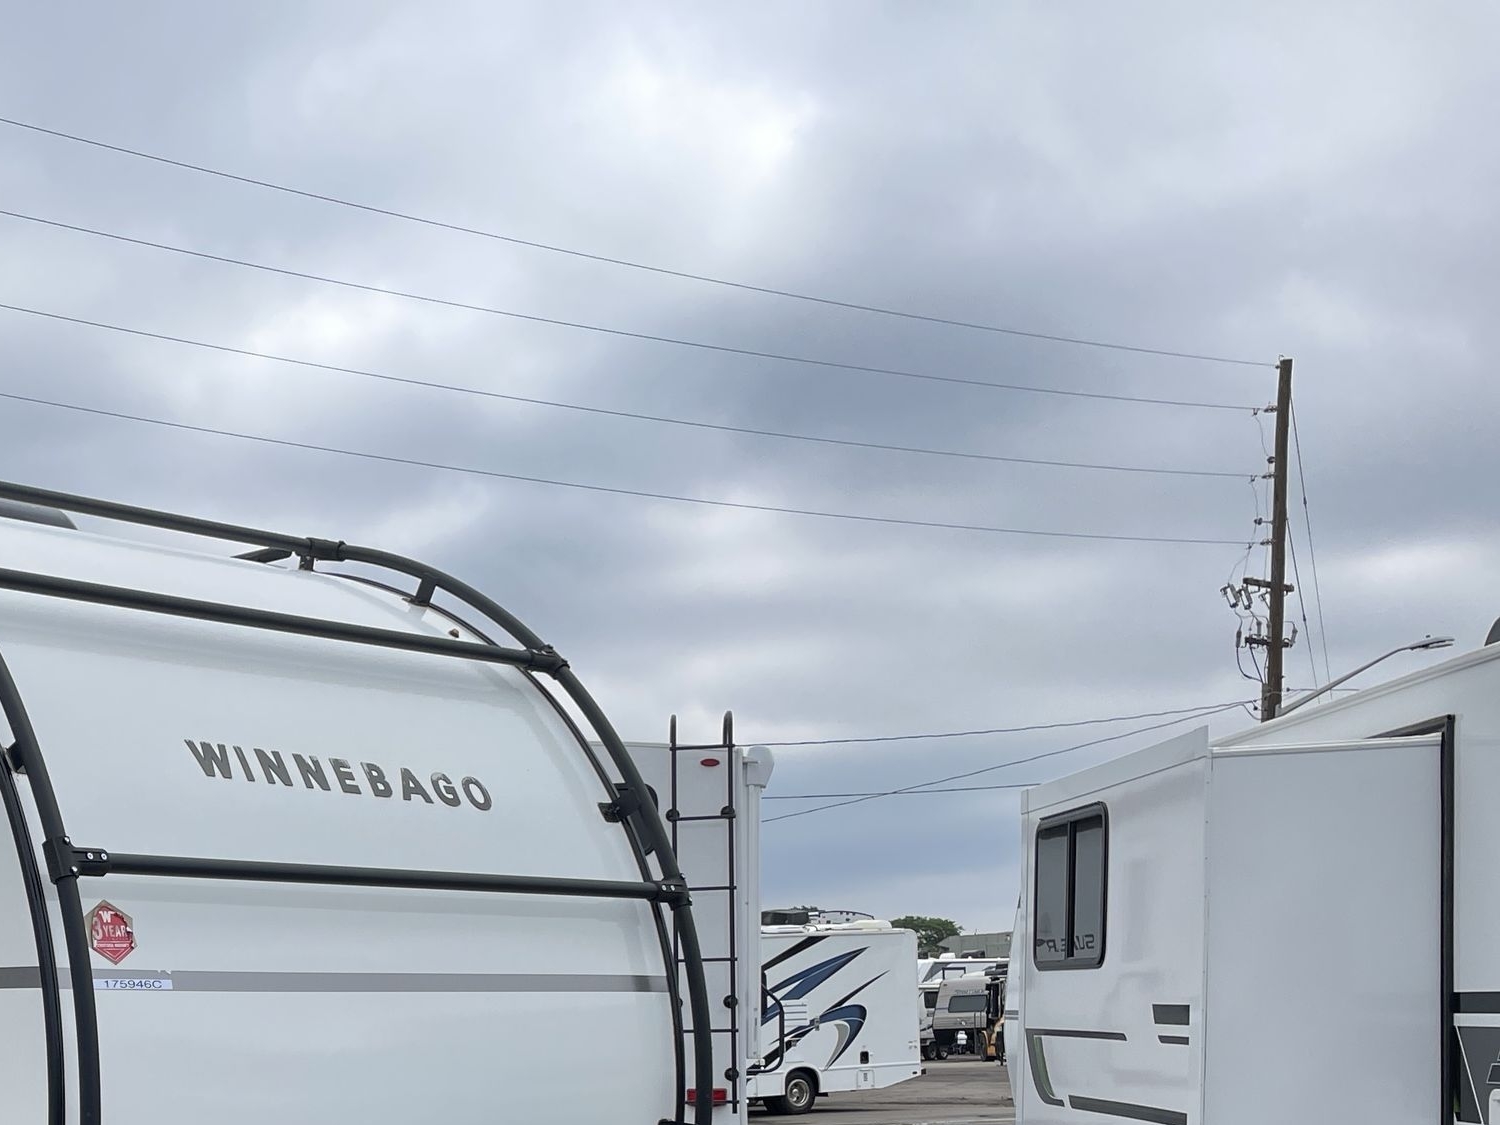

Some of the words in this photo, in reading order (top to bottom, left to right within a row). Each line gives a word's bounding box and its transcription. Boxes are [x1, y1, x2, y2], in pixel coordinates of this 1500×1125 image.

[184, 739, 493, 811] WINNEBAGO
[102, 925, 128, 938] YEAR
[104, 980, 162, 989] 175946C
